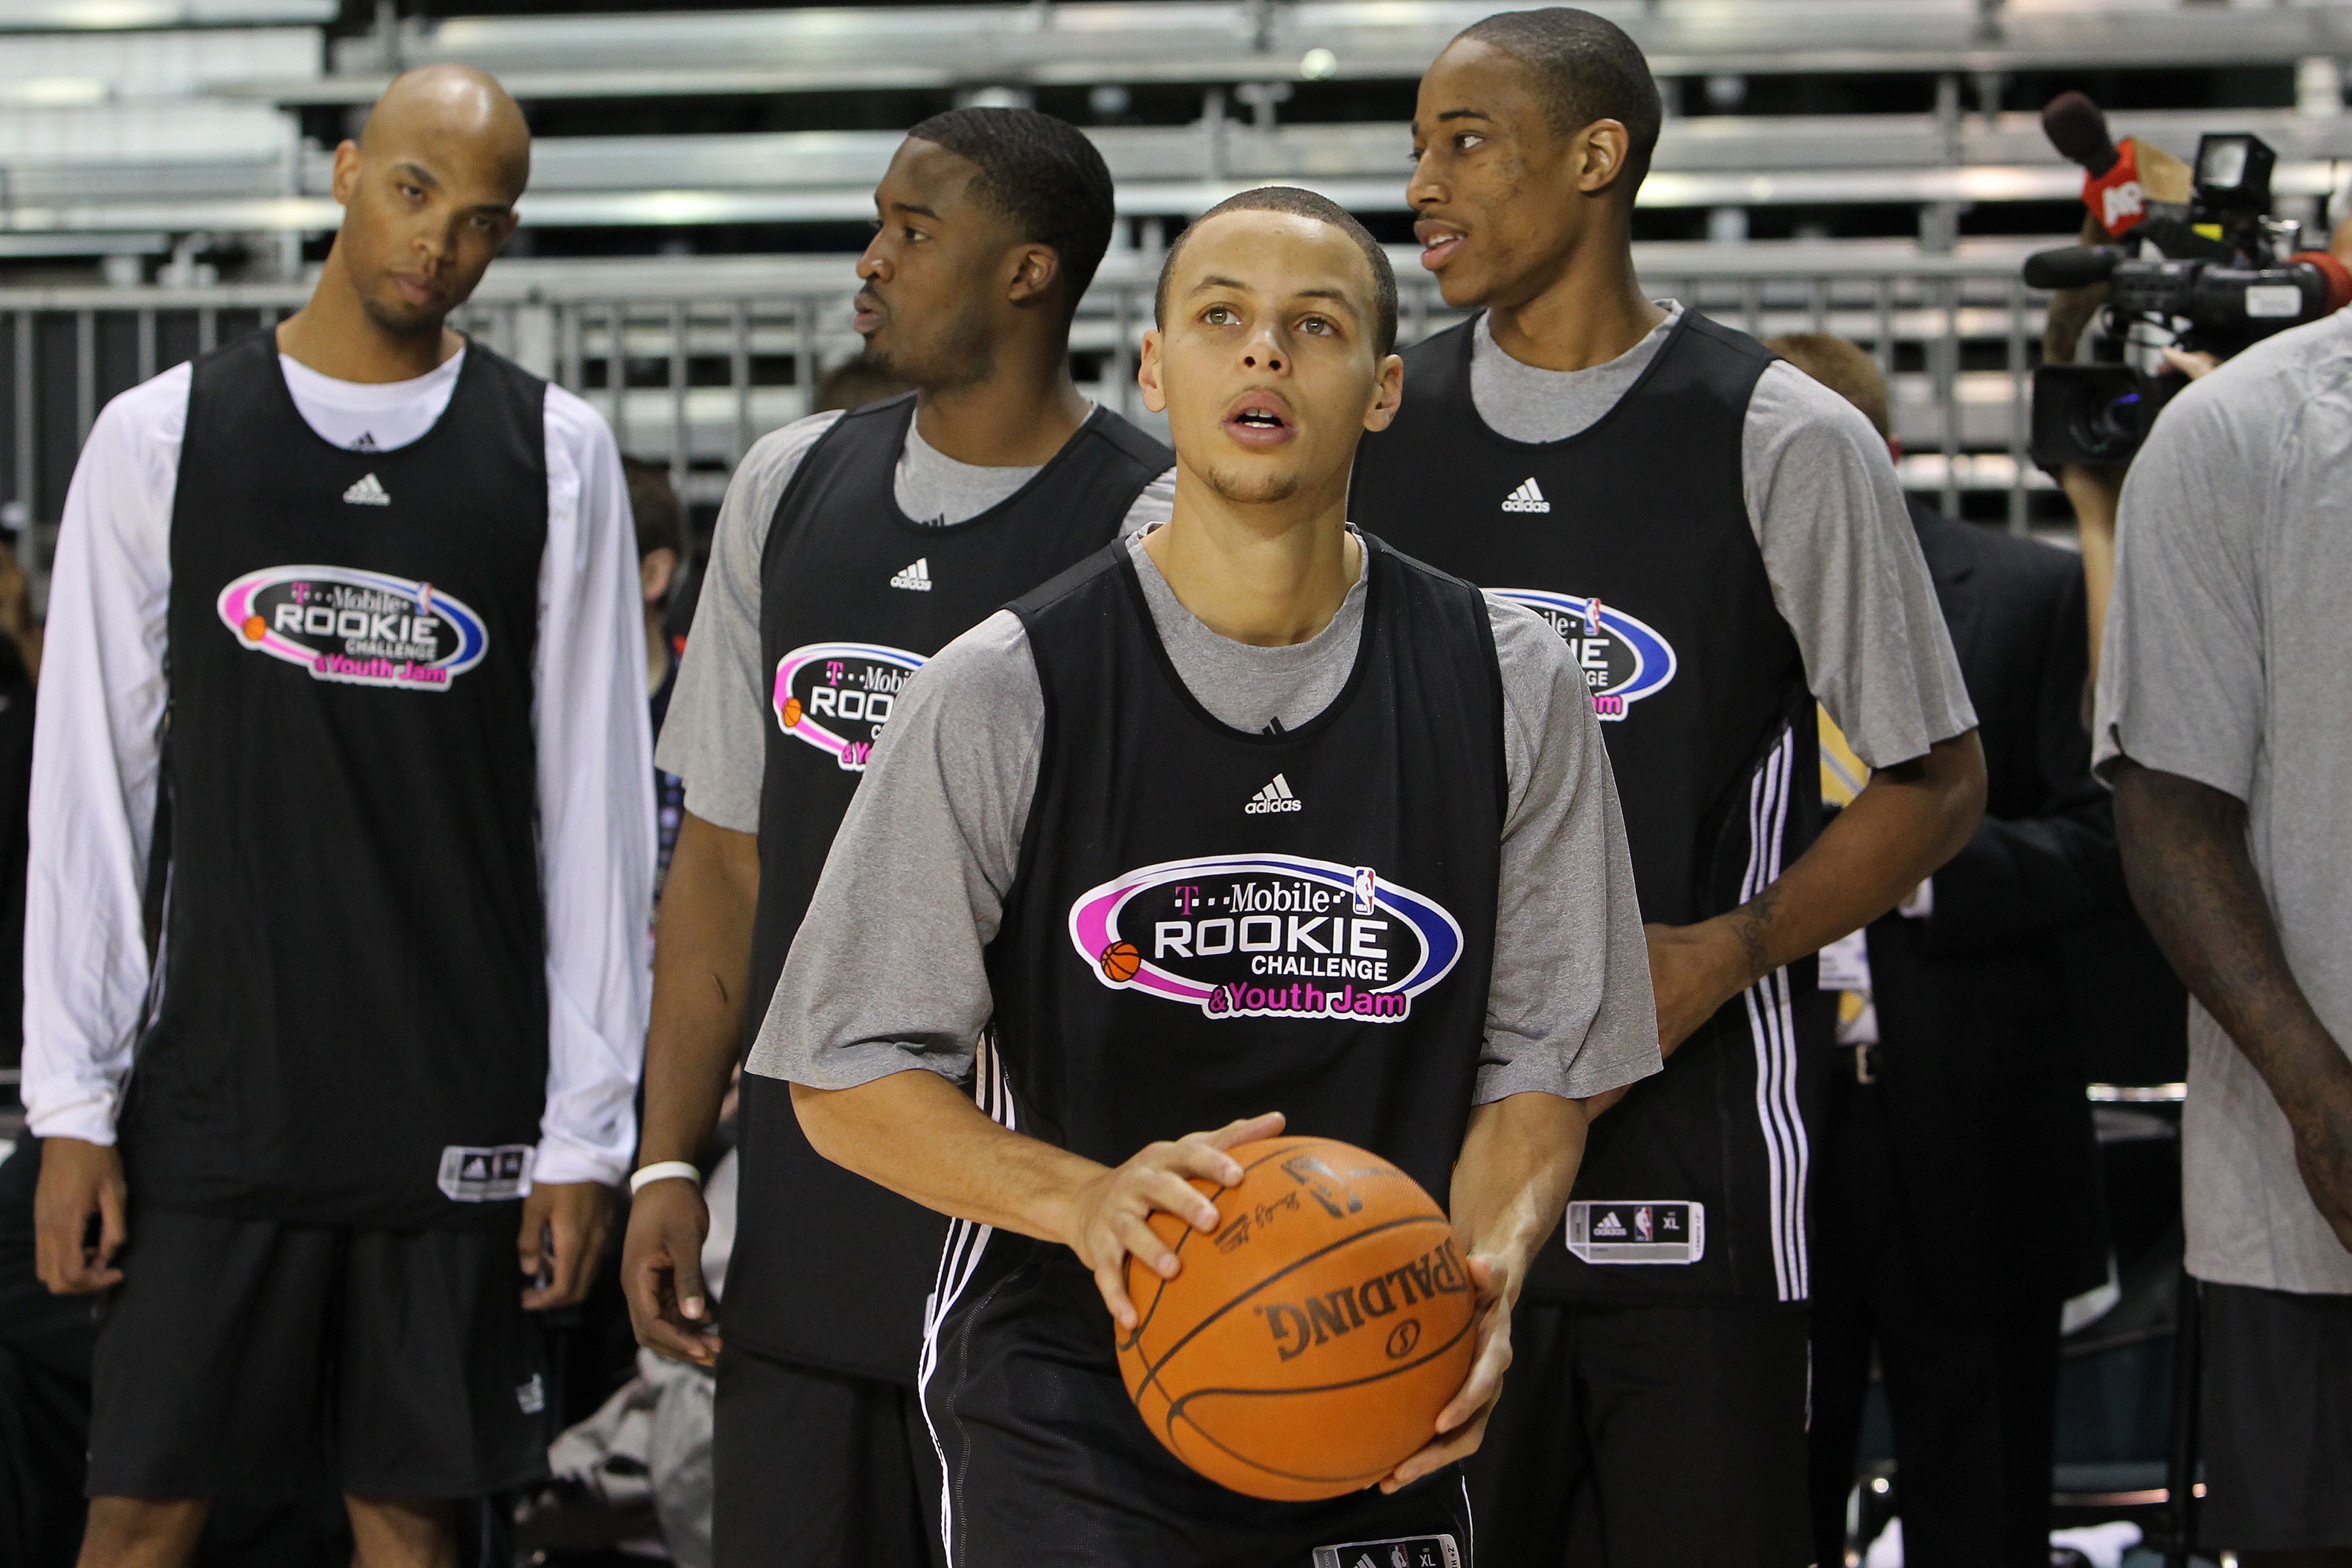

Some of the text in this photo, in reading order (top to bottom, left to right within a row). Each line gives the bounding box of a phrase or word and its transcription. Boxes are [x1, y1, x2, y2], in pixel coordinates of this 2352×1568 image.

[1501, 500, 1550, 513] adidas
[274, 604, 440, 645] ROOKIE
[399, 660, 446, 683] Jam
[1244, 798, 1302, 815] adidas
[1154, 915, 1388, 960] ROOKIE
[1250, 955, 1388, 982] CHALLENGE
[1331, 984, 1405, 1016] Jam
[1662, 1217, 1680, 1230] XL
[1262, 1237, 1467, 1362] SPALDING
[1419, 1554, 1436, 1567] XL
